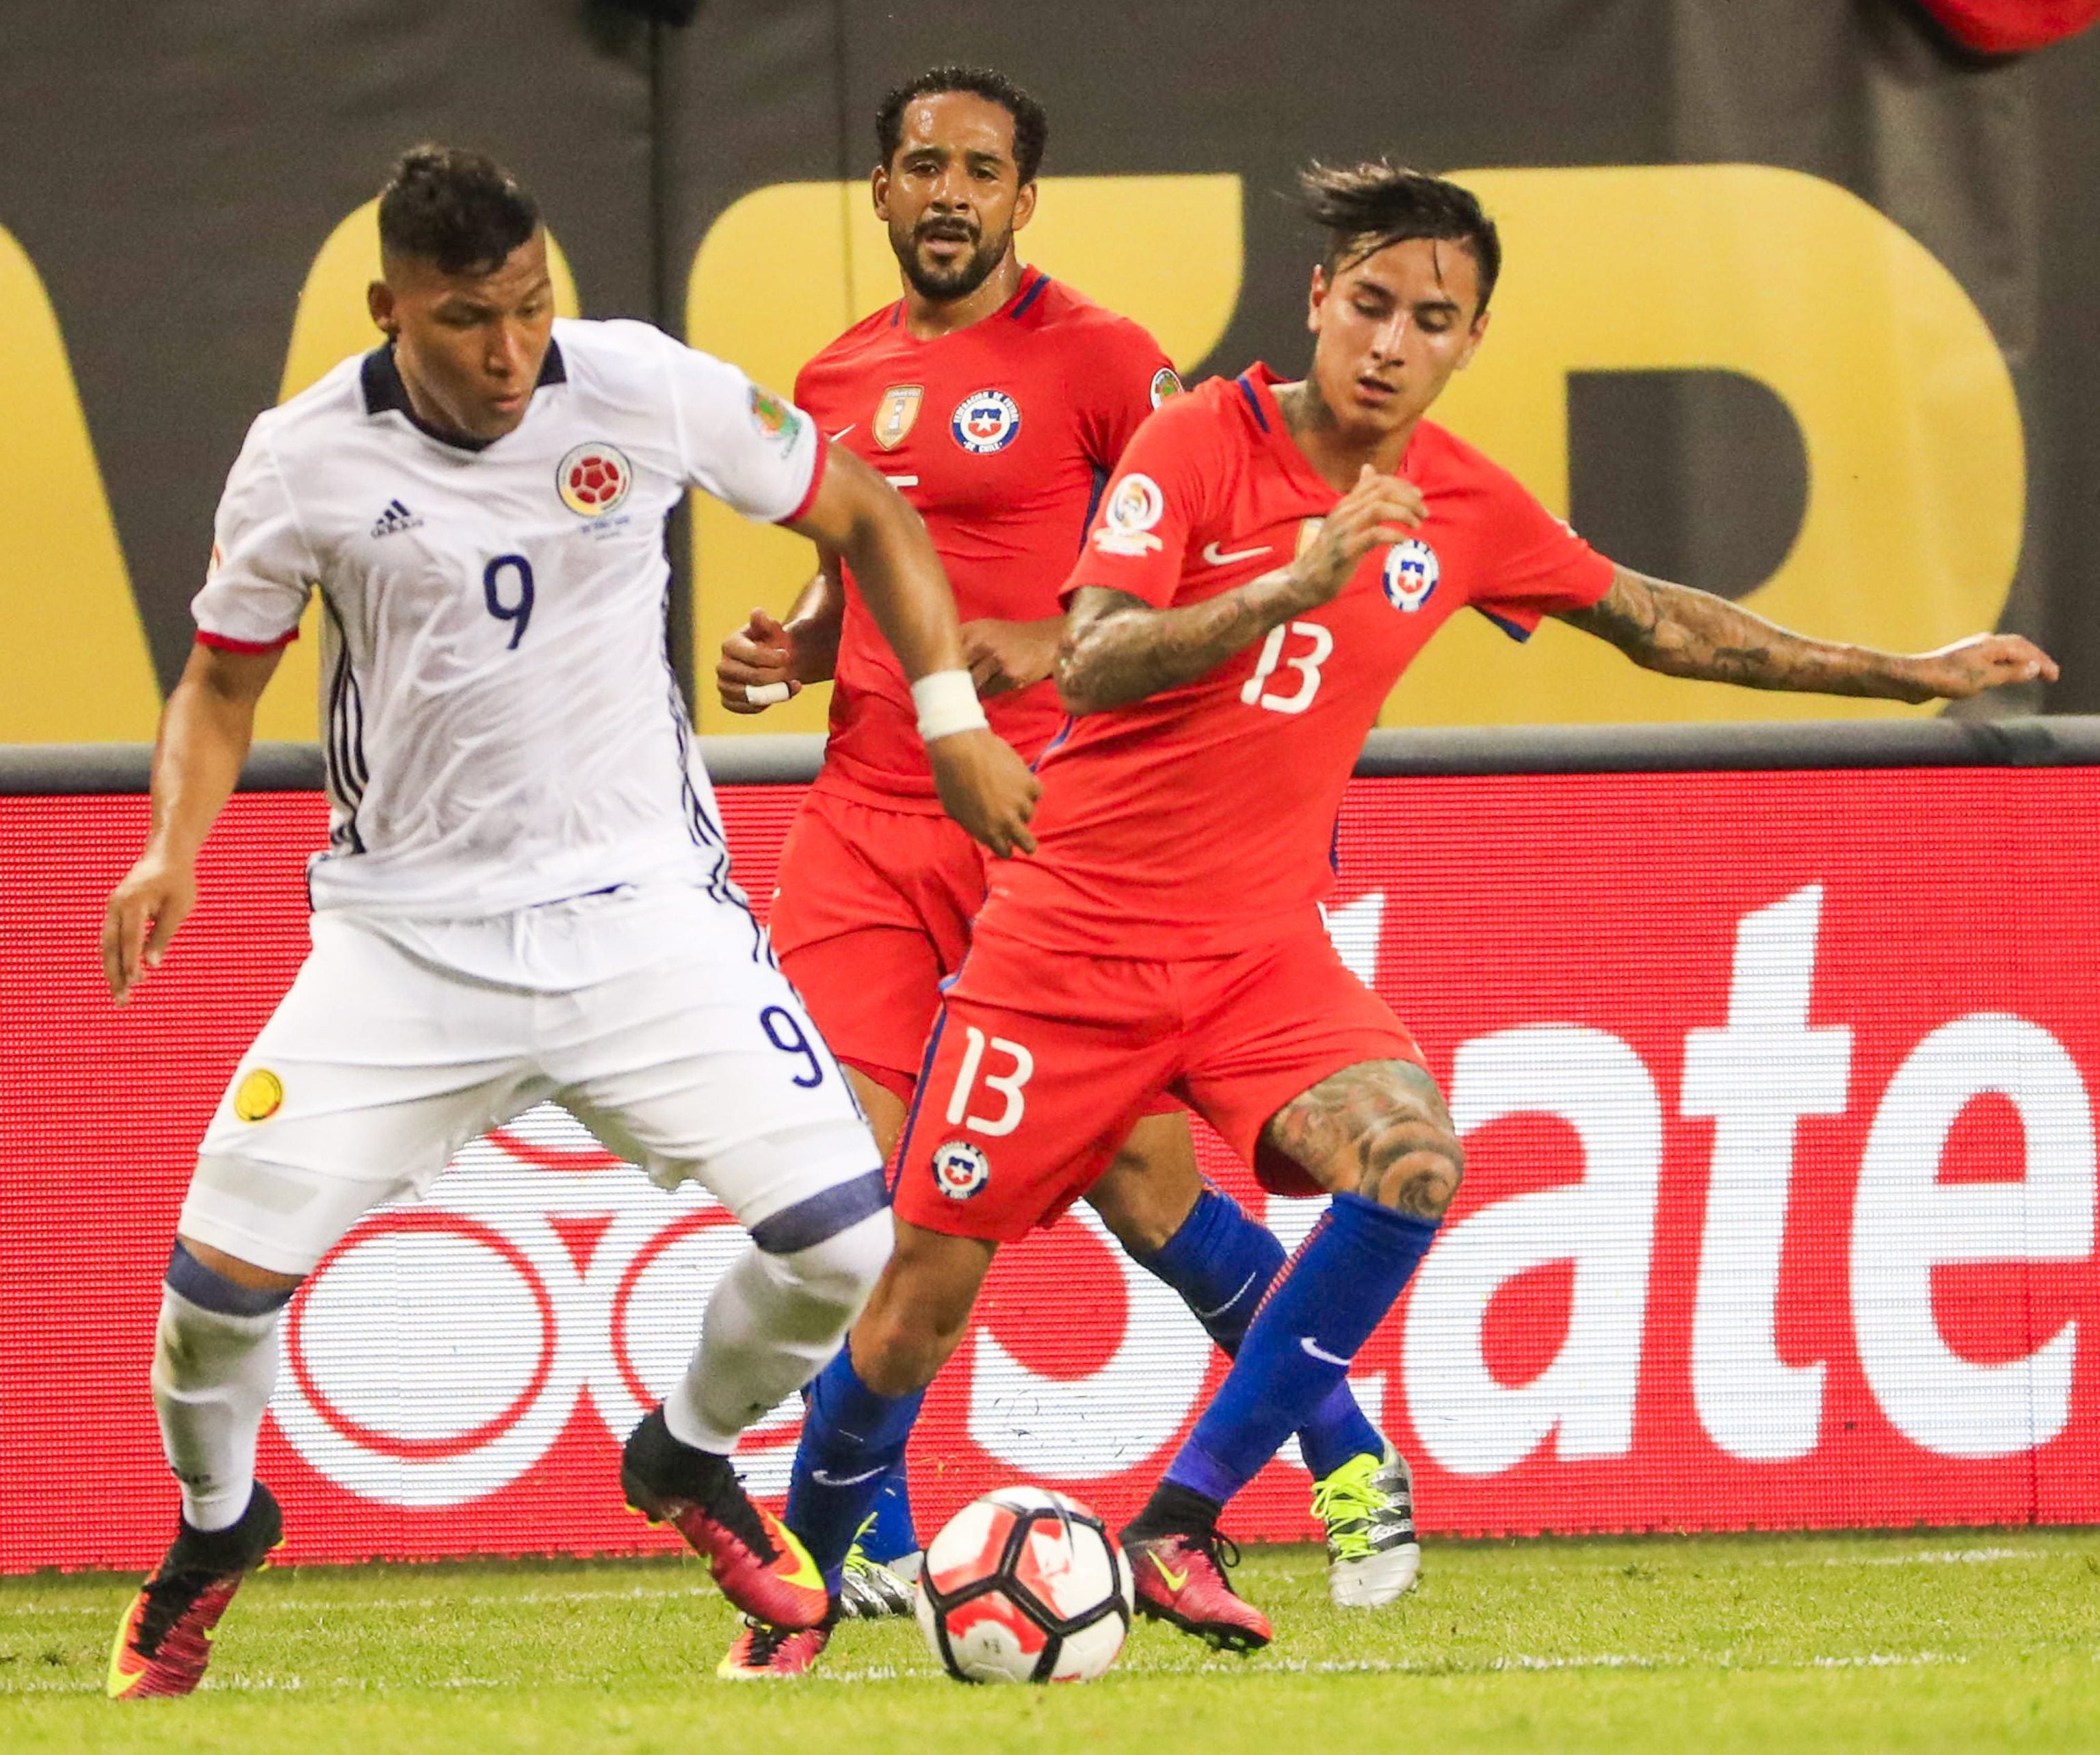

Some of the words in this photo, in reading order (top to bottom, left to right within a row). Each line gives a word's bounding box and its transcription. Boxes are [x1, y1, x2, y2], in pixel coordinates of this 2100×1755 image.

[483, 554, 534, 650] 9
[1239, 621, 1334, 714] 13
[760, 1005, 823, 1089] 9
[946, 1026, 1034, 1136] 13
[968, 884, 2099, 1479] ate
